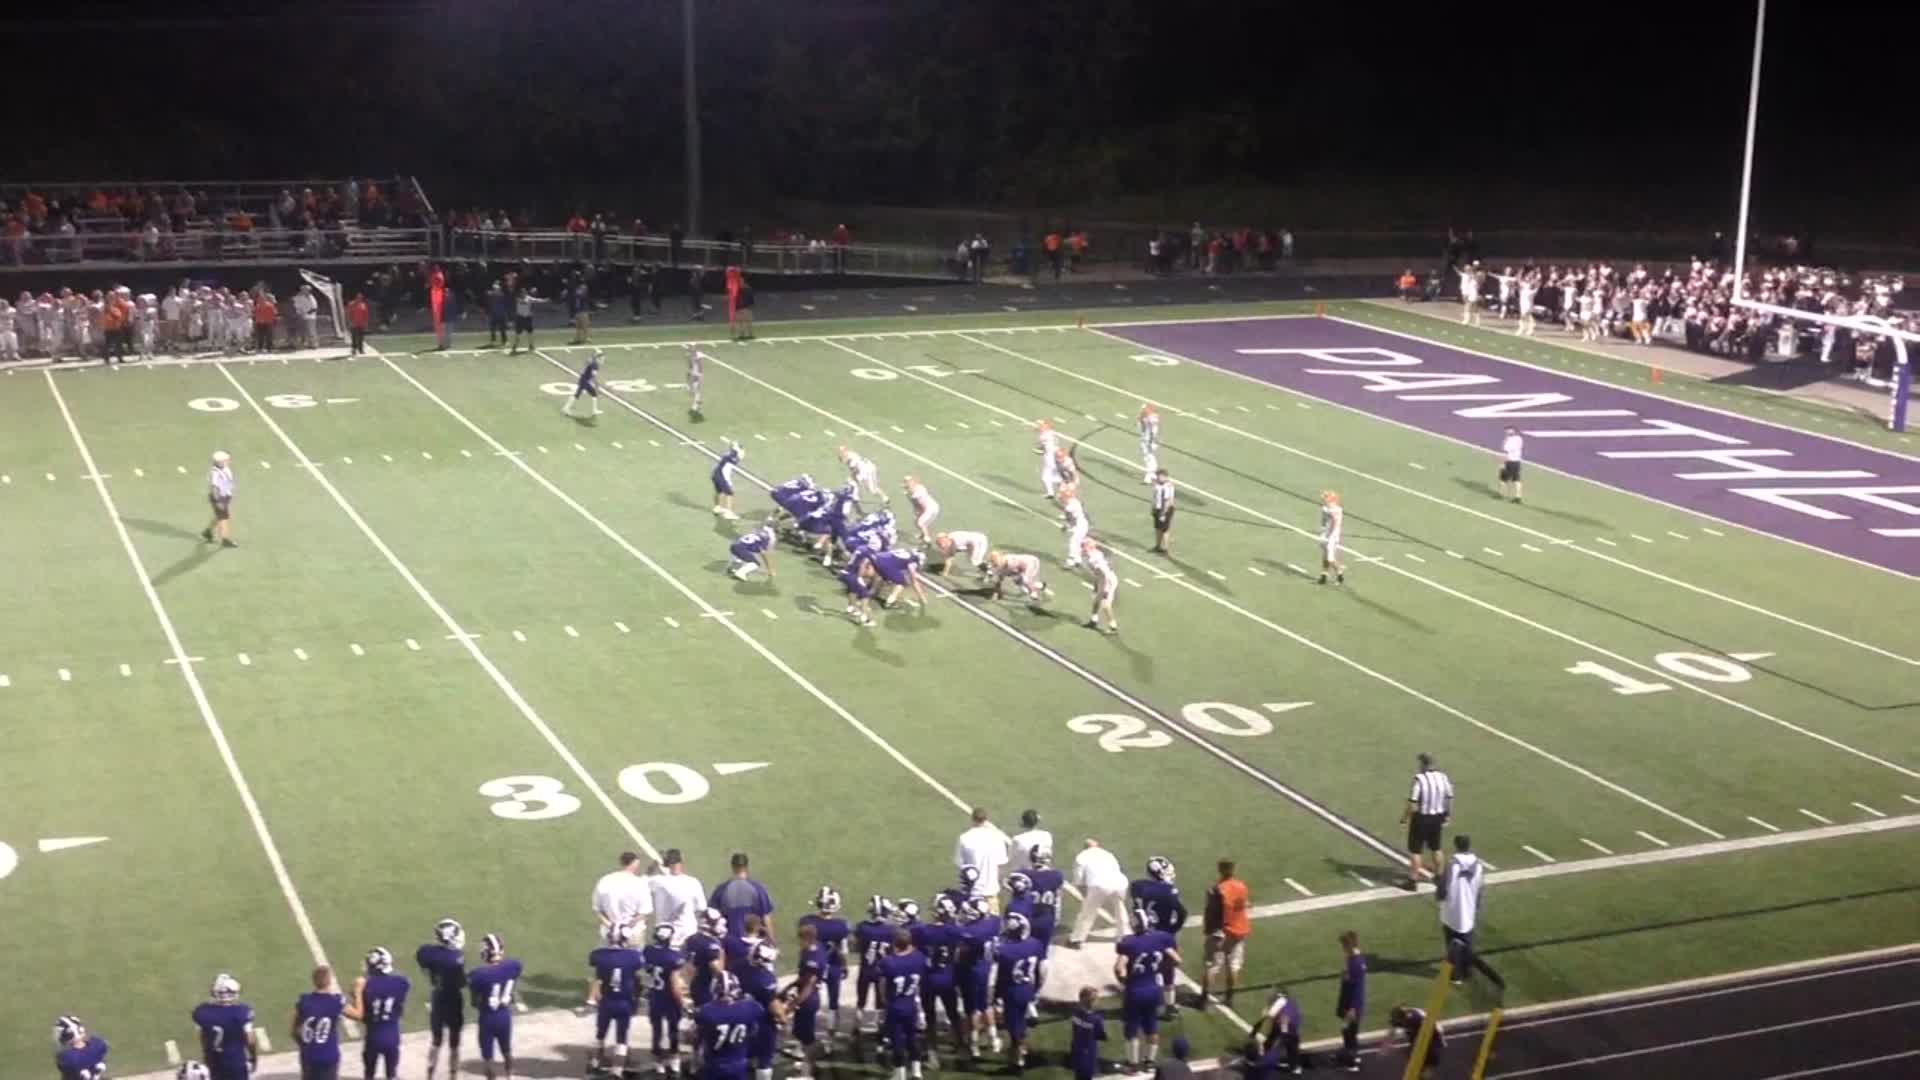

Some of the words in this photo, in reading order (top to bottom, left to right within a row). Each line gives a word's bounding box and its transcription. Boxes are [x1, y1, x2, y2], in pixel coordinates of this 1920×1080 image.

[1564, 652, 1753, 695] 10
[1066, 702, 1274, 752] 20
[479, 761, 710, 820] 30
[301, 1016, 332, 1044] 60
